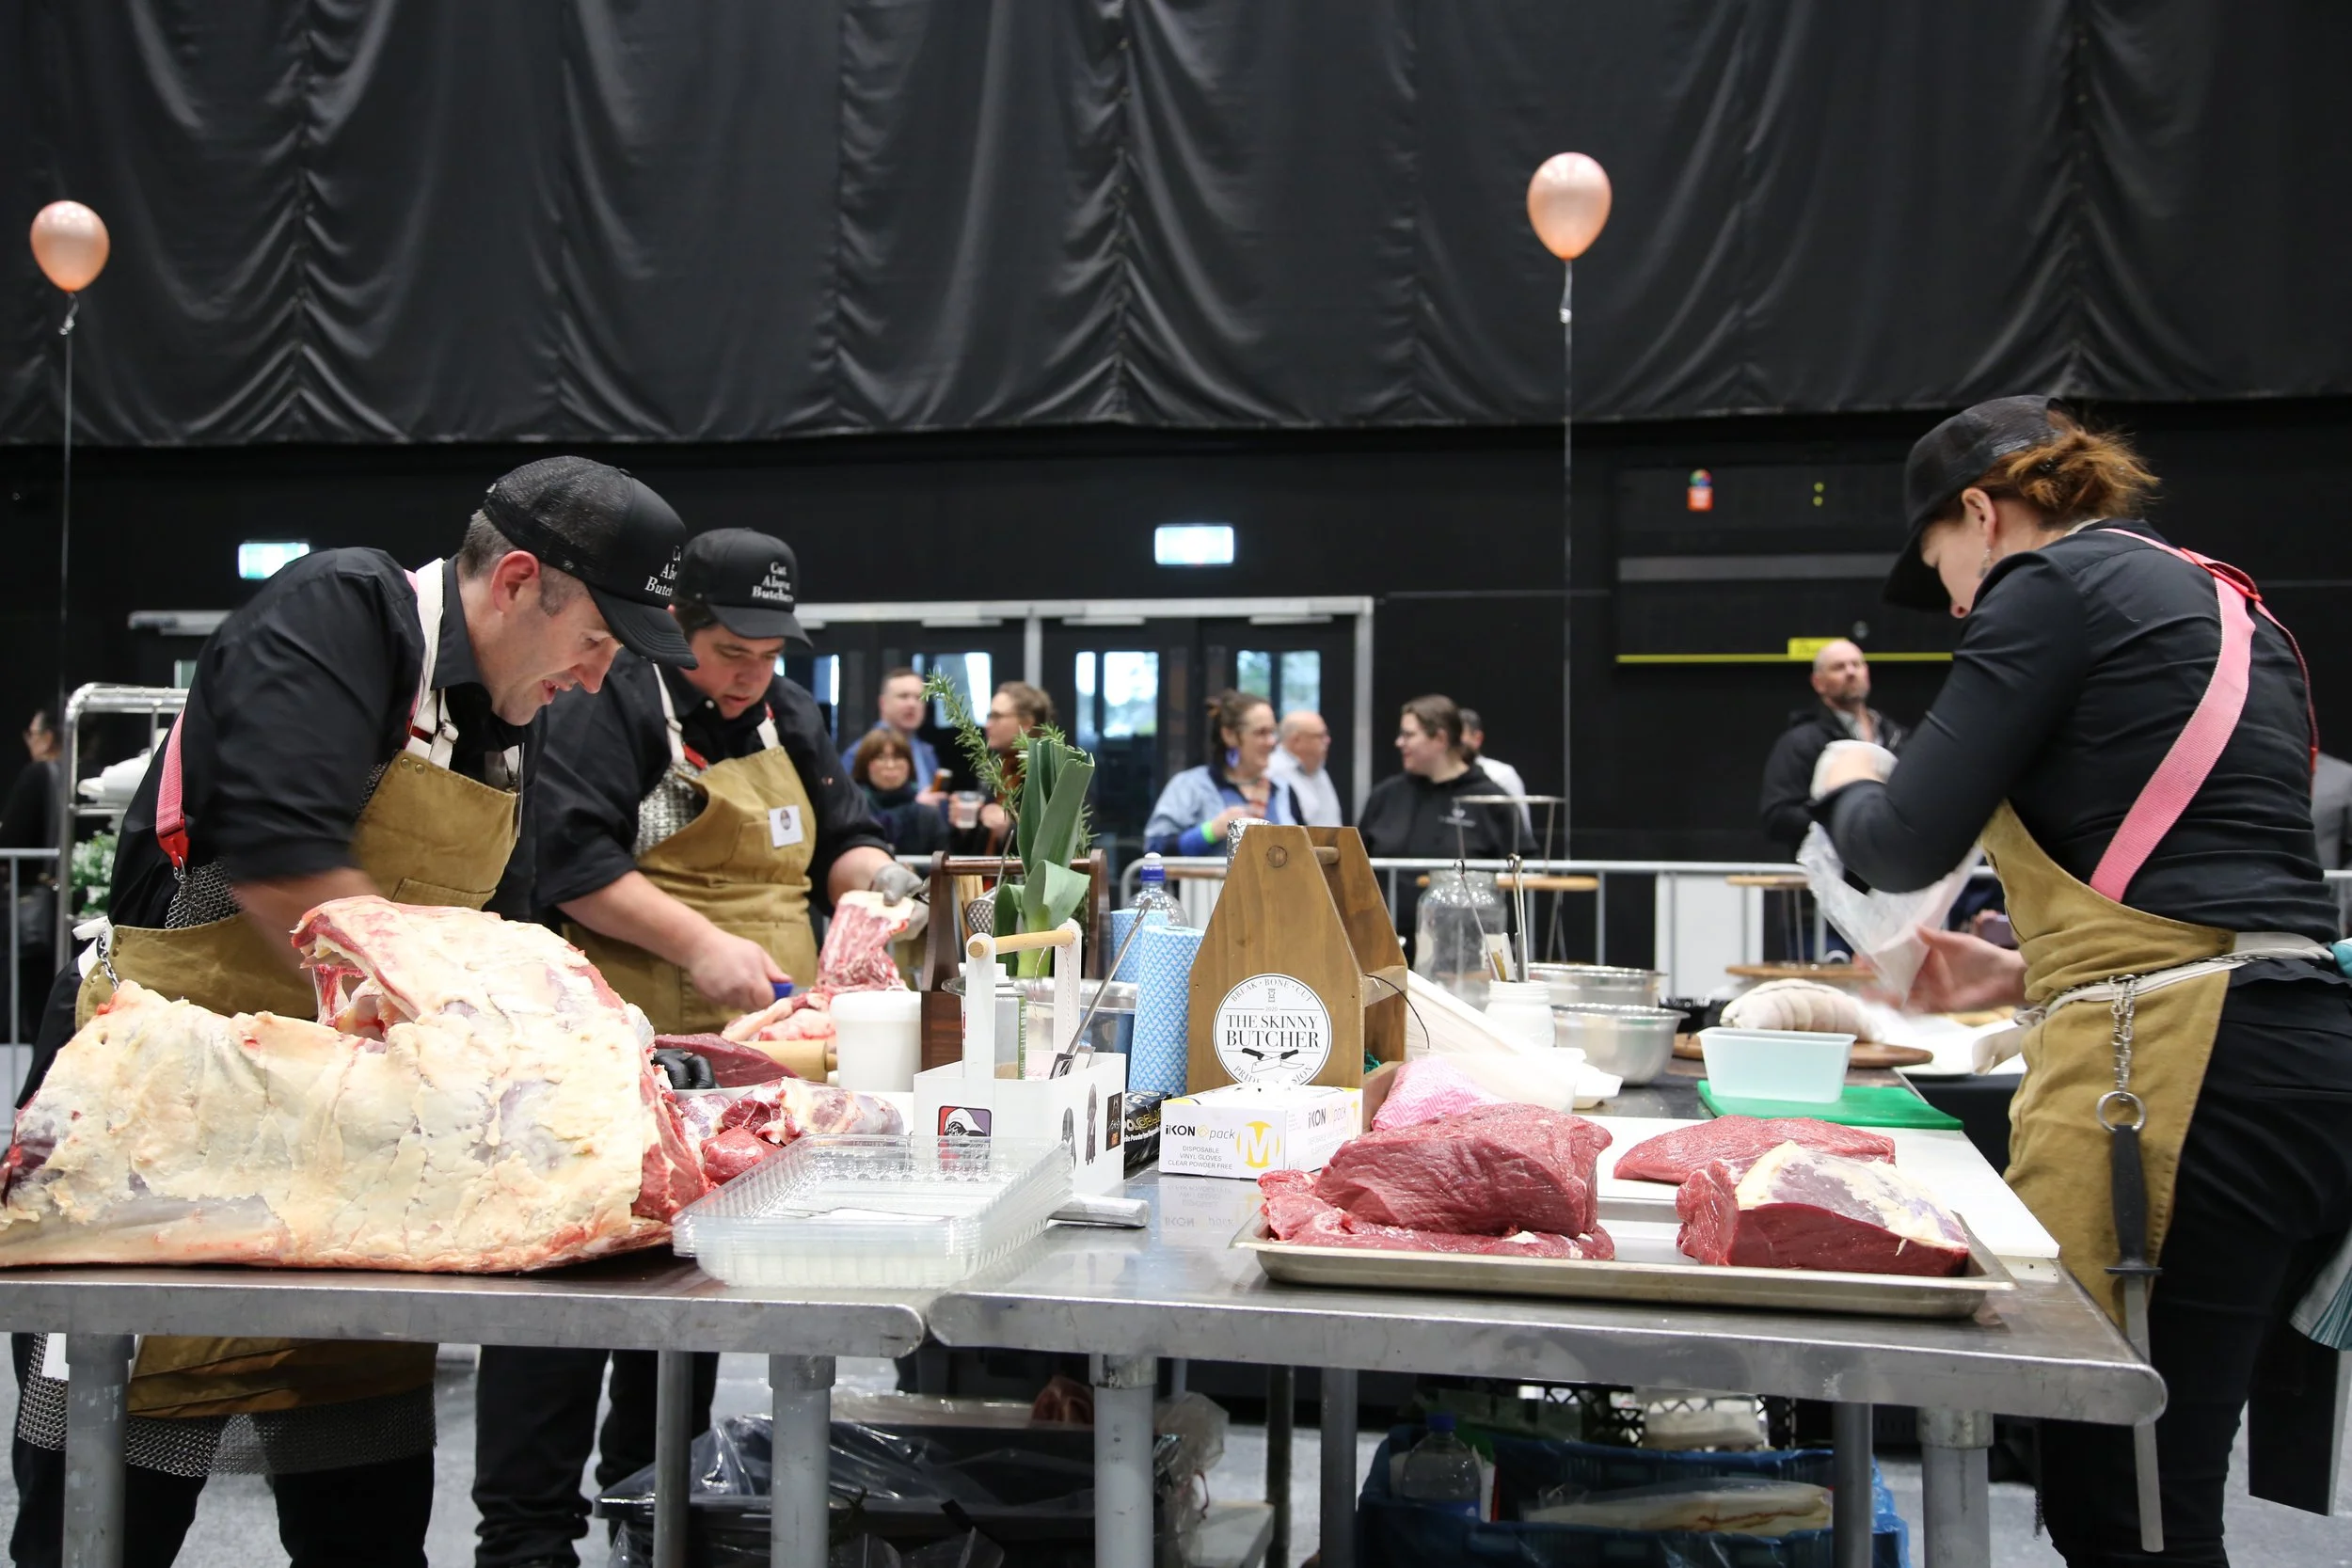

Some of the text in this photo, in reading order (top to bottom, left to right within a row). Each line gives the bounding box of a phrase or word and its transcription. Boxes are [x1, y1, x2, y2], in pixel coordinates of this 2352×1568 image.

[660, 563, 678, 580] Abo
[644, 576, 673, 596] Butc
[1231, 978, 1312, 1002] BREAK BONE CUT
[1226, 1014, 1318, 1029] THE SKINNY
[1226, 1030, 1320, 1048] BUTCHER
[1292, 1067, 1313, 1085] SION
[1166, 1125, 1195, 1137] iKON
[1209, 1129, 1236, 1141] pack
